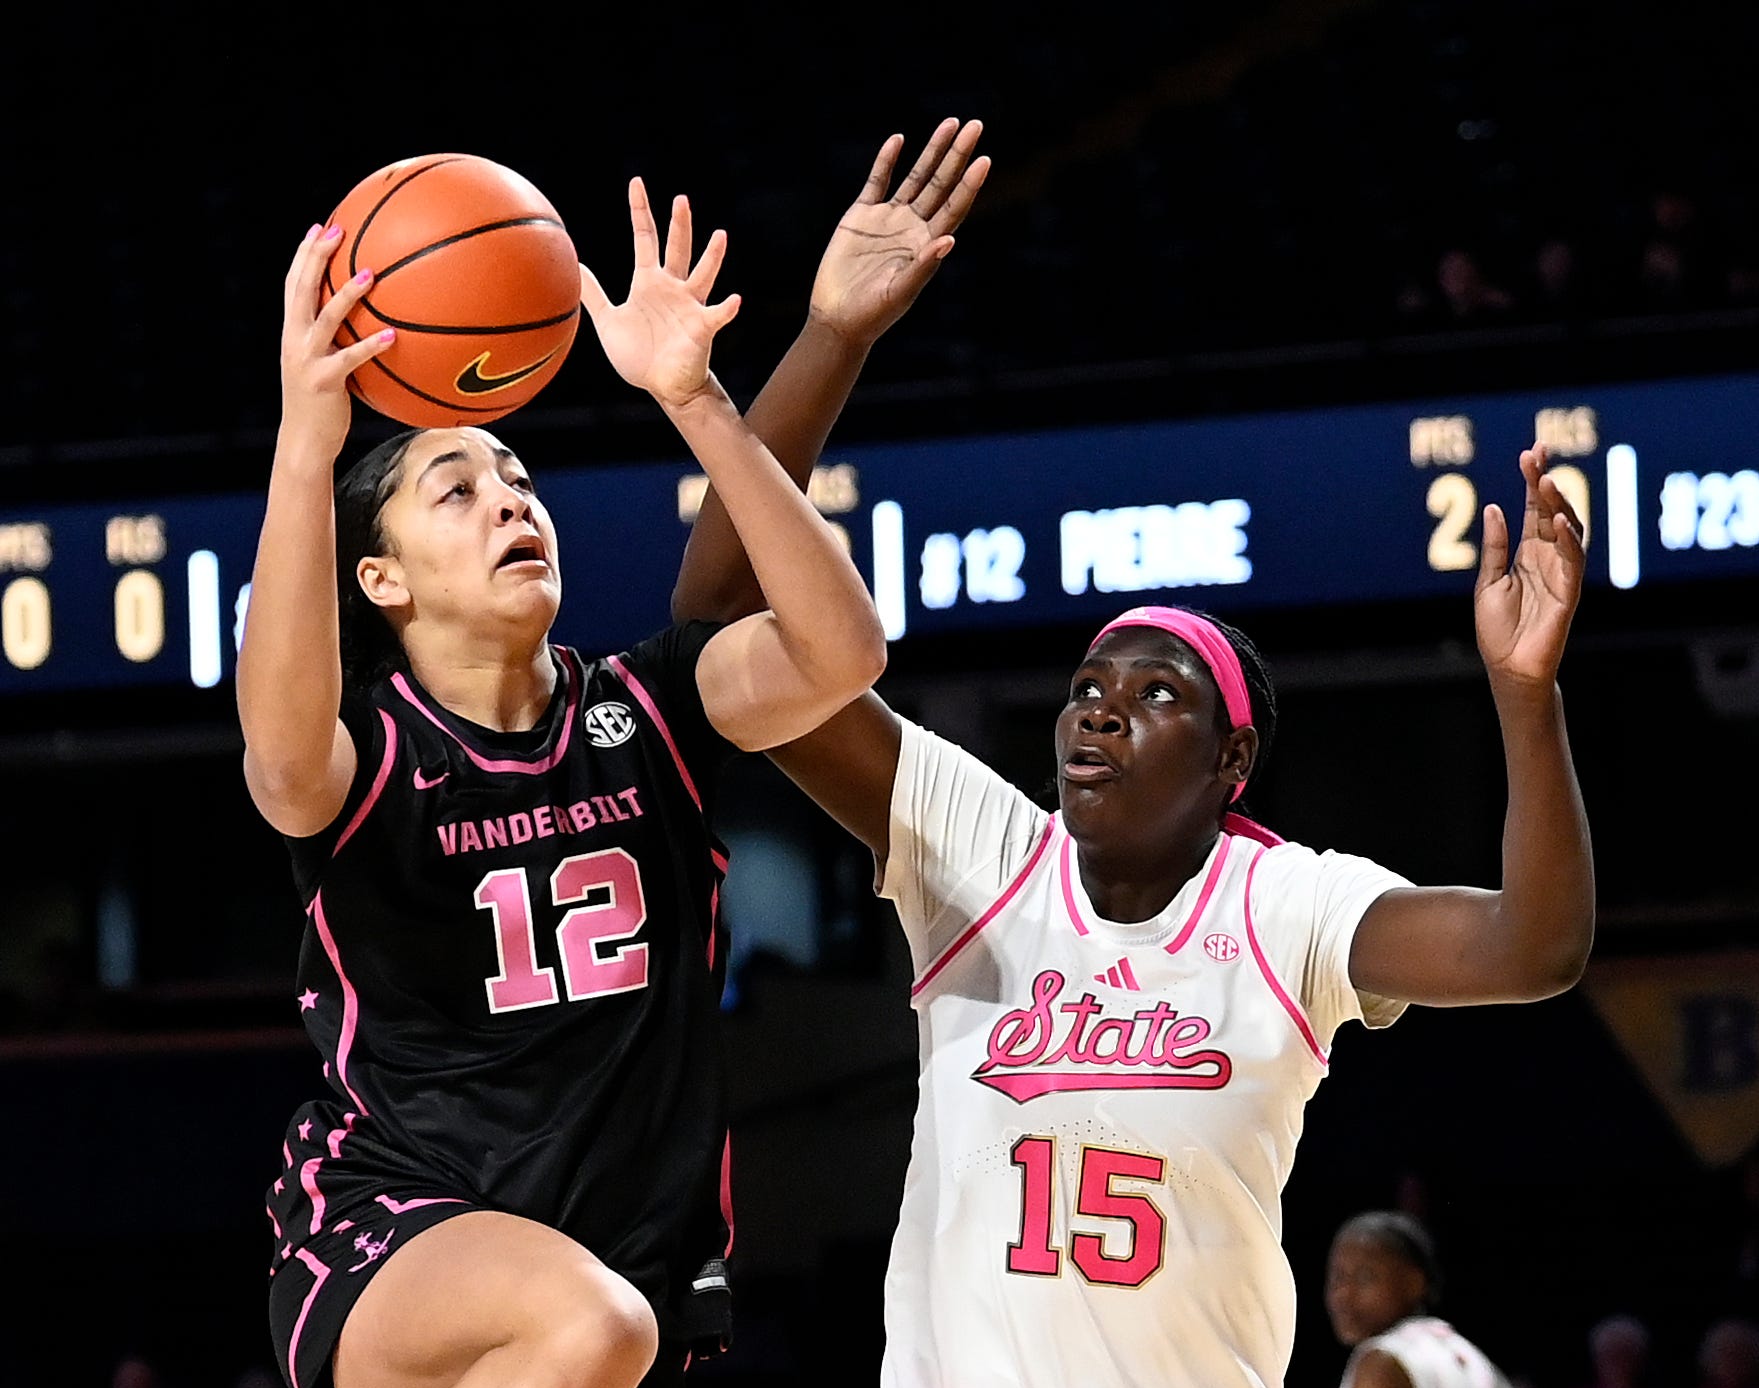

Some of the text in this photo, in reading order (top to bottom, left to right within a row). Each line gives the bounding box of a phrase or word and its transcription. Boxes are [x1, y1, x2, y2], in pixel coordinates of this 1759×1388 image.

[1427, 473, 1477, 571] 2
[2, 577, 51, 668] 0
[114, 570, 164, 662] 0
[585, 702, 636, 747] SEC
[437, 787, 644, 856] VANDERBILT
[474, 847, 649, 1014] 12
[1203, 933, 1239, 961] SEC
[972, 969, 1232, 1105] State
[1005, 1133, 1168, 1291] 15
